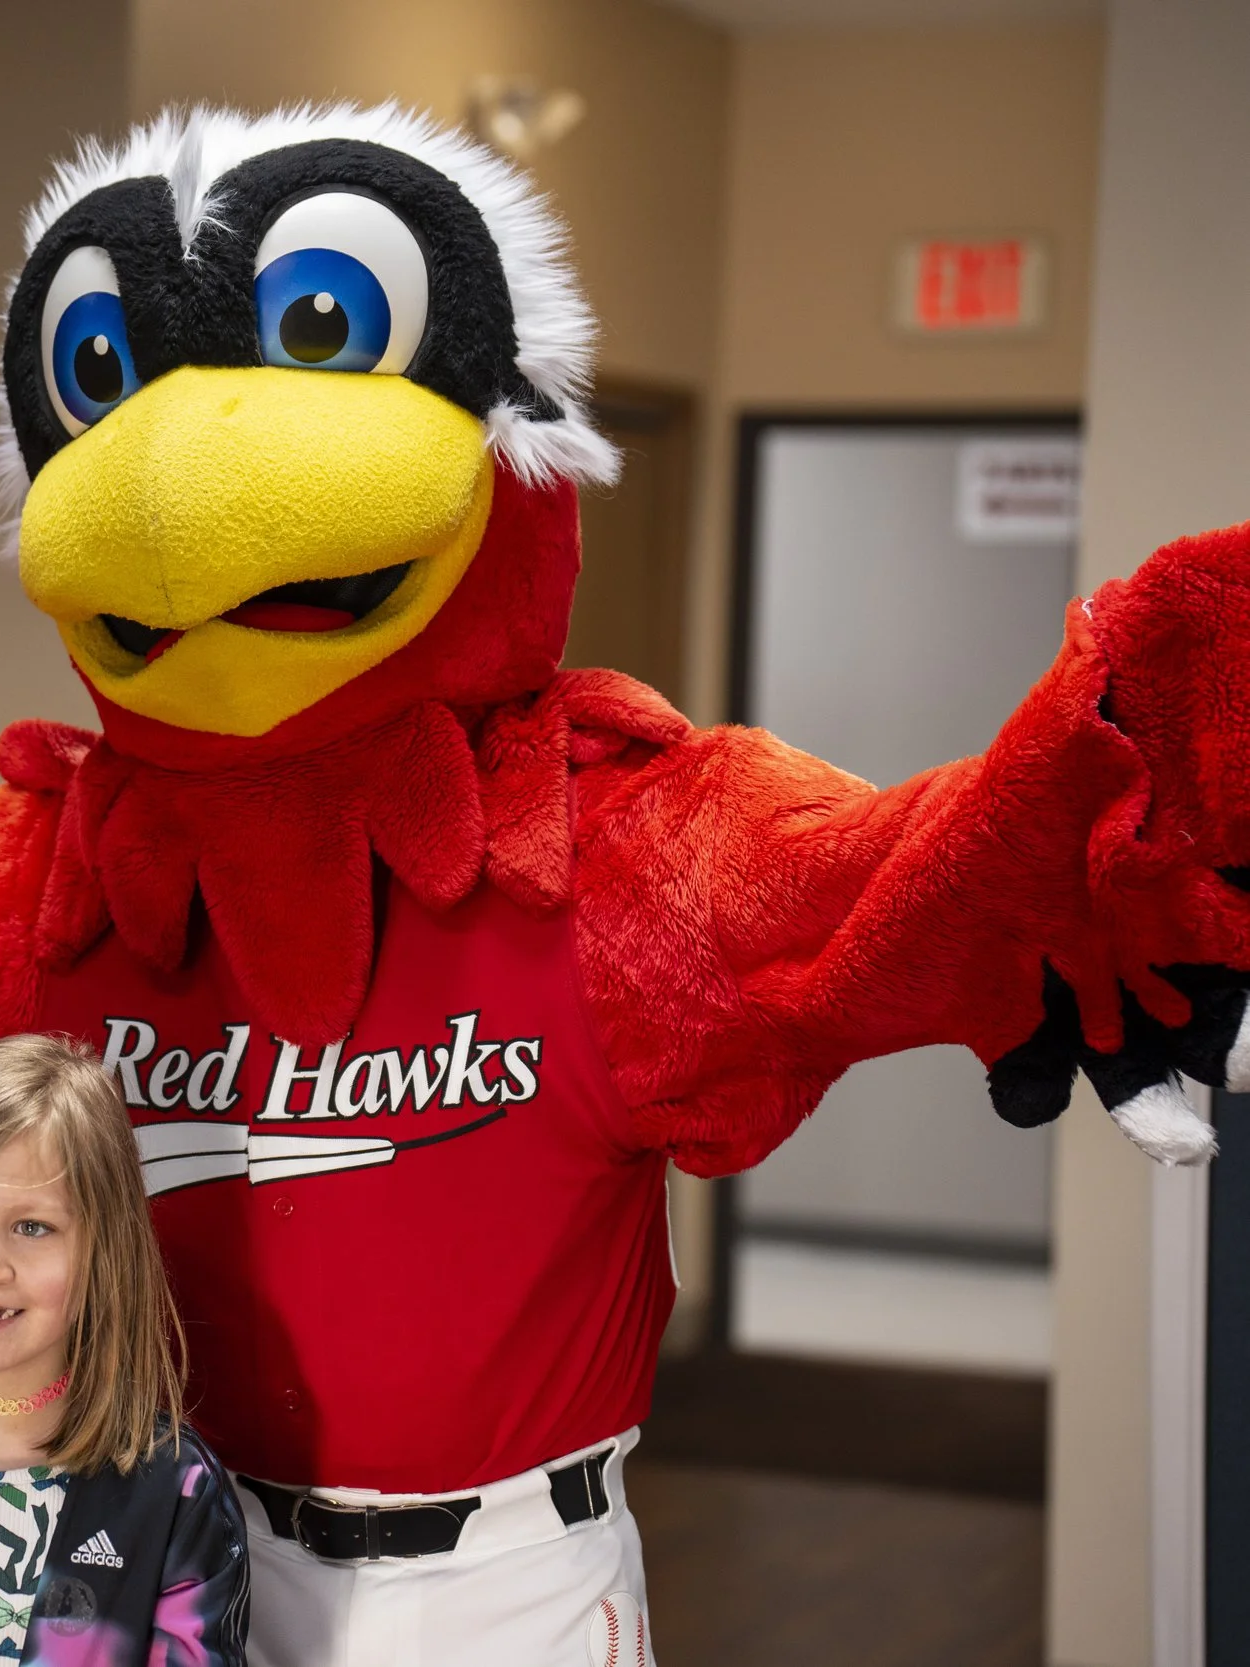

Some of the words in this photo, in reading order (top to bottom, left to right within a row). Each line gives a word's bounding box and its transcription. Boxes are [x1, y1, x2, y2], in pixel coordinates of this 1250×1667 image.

[916, 240, 1024, 328] EXIT
[101, 1017, 251, 1112] Red
[257, 1011, 541, 1122] Hawks
[70, 1550, 124, 1568] adidas
